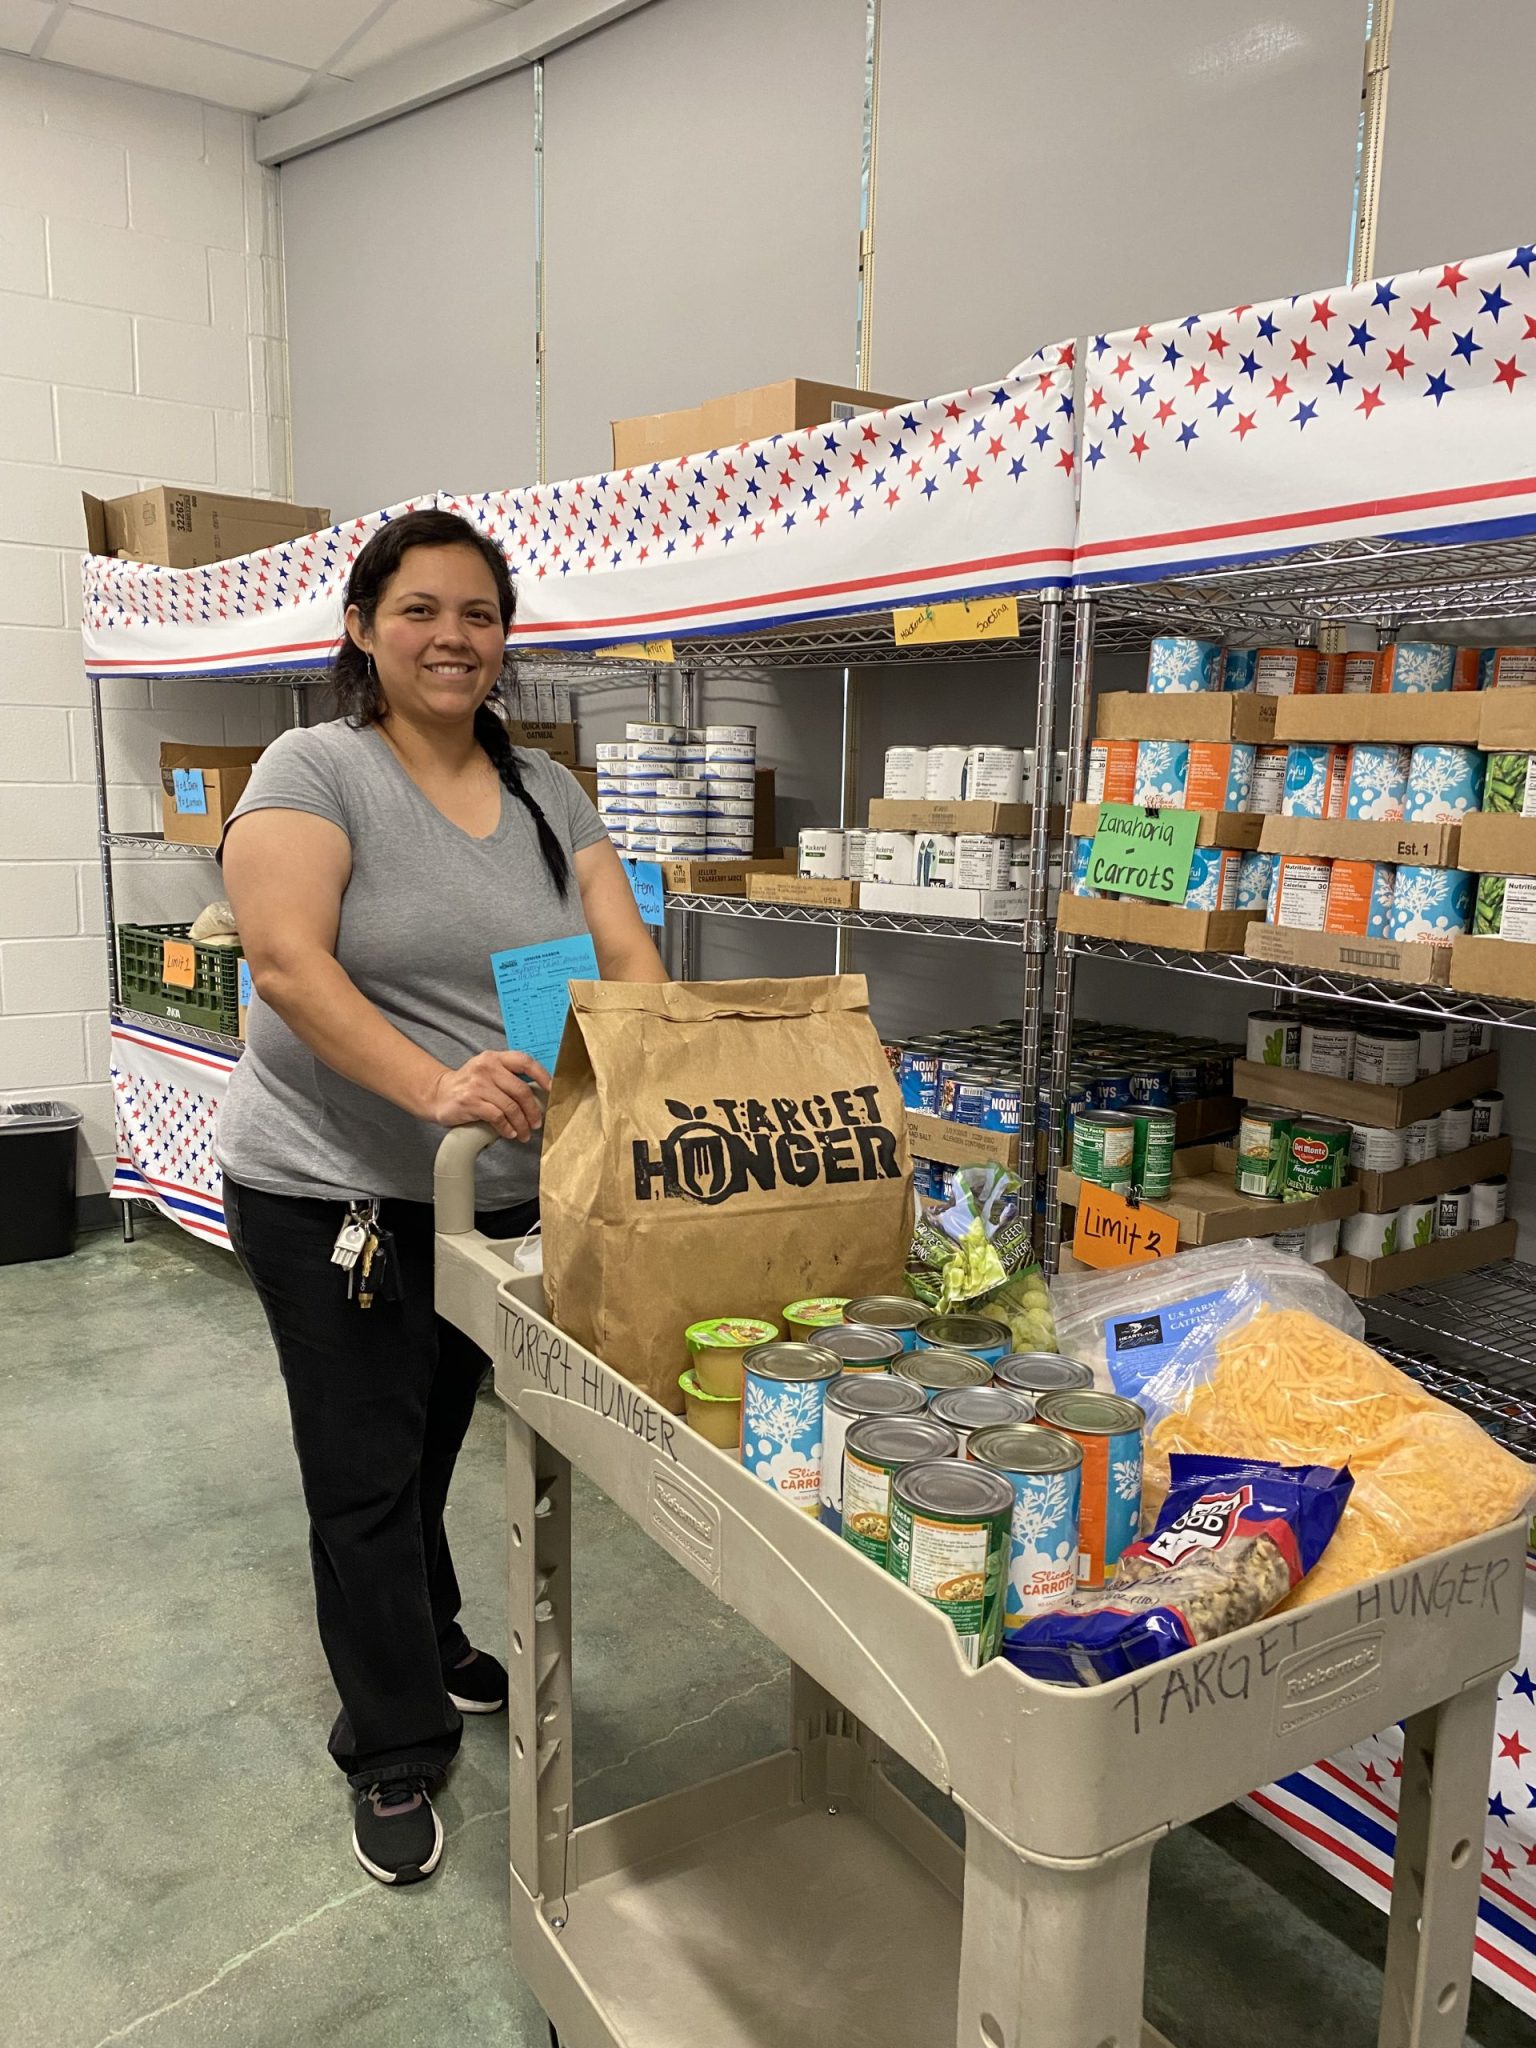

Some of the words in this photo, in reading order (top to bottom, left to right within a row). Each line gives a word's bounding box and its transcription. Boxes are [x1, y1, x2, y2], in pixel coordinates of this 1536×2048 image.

[1097, 812, 1174, 847] Zanahoria
[1397, 841, 1419, 856] Est.
[1423, 843, 1429, 856] 1
[1093, 858, 1174, 891] Carrots
[713, 1085, 882, 1133] TARGET
[1294, 1142, 1304, 1152] Del
[1304, 1144, 1326, 1156] Monte
[632, 1120, 902, 1206] HUNGER
[1286, 1177, 1305, 1190] GREEN
[1297, 1174, 1312, 1184] CUT
[1085, 1206, 1142, 1255] Limit
[1144, 1230, 1161, 1257] 2
[1168, 1311, 1187, 1322] U.S.
[1118, 1328, 1160, 1341] HEARTLAND
[898, 1537, 910, 1551] 20
[1031, 1565, 1072, 1584] Sliced
[1022, 1574, 1074, 1596] CARROTS
[1113, 1615, 1314, 1735] TARGET
[1356, 1557, 1511, 1626] HUNGER
